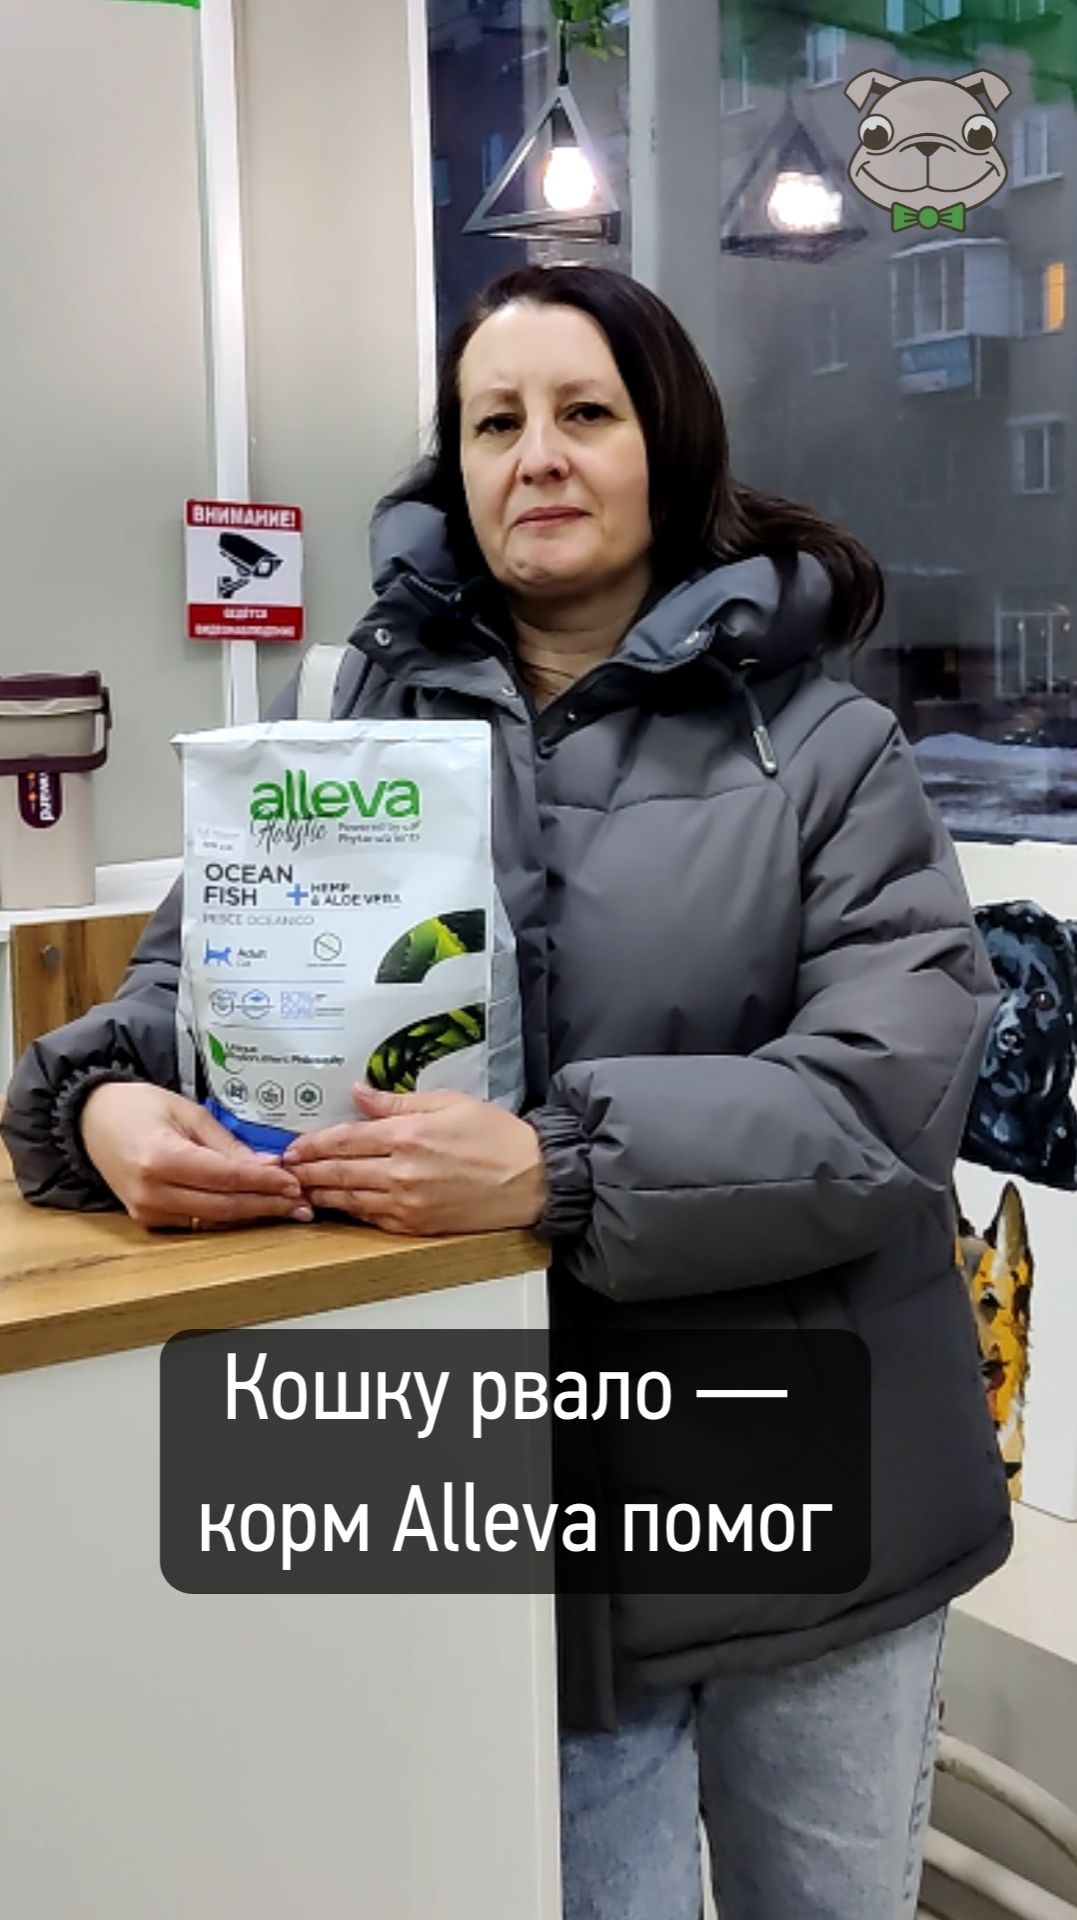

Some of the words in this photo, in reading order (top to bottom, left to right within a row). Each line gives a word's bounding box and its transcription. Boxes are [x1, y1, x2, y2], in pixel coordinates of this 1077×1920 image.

[192, 504, 296, 527] ВНИМАНИЕ!
[250, 769, 420, 820] alleva
[204, 863, 293, 884] OCEAN
[203, 886, 257, 906] FISH
[310, 883, 350, 894] HEMP
[323, 894, 361, 906] ALOE
